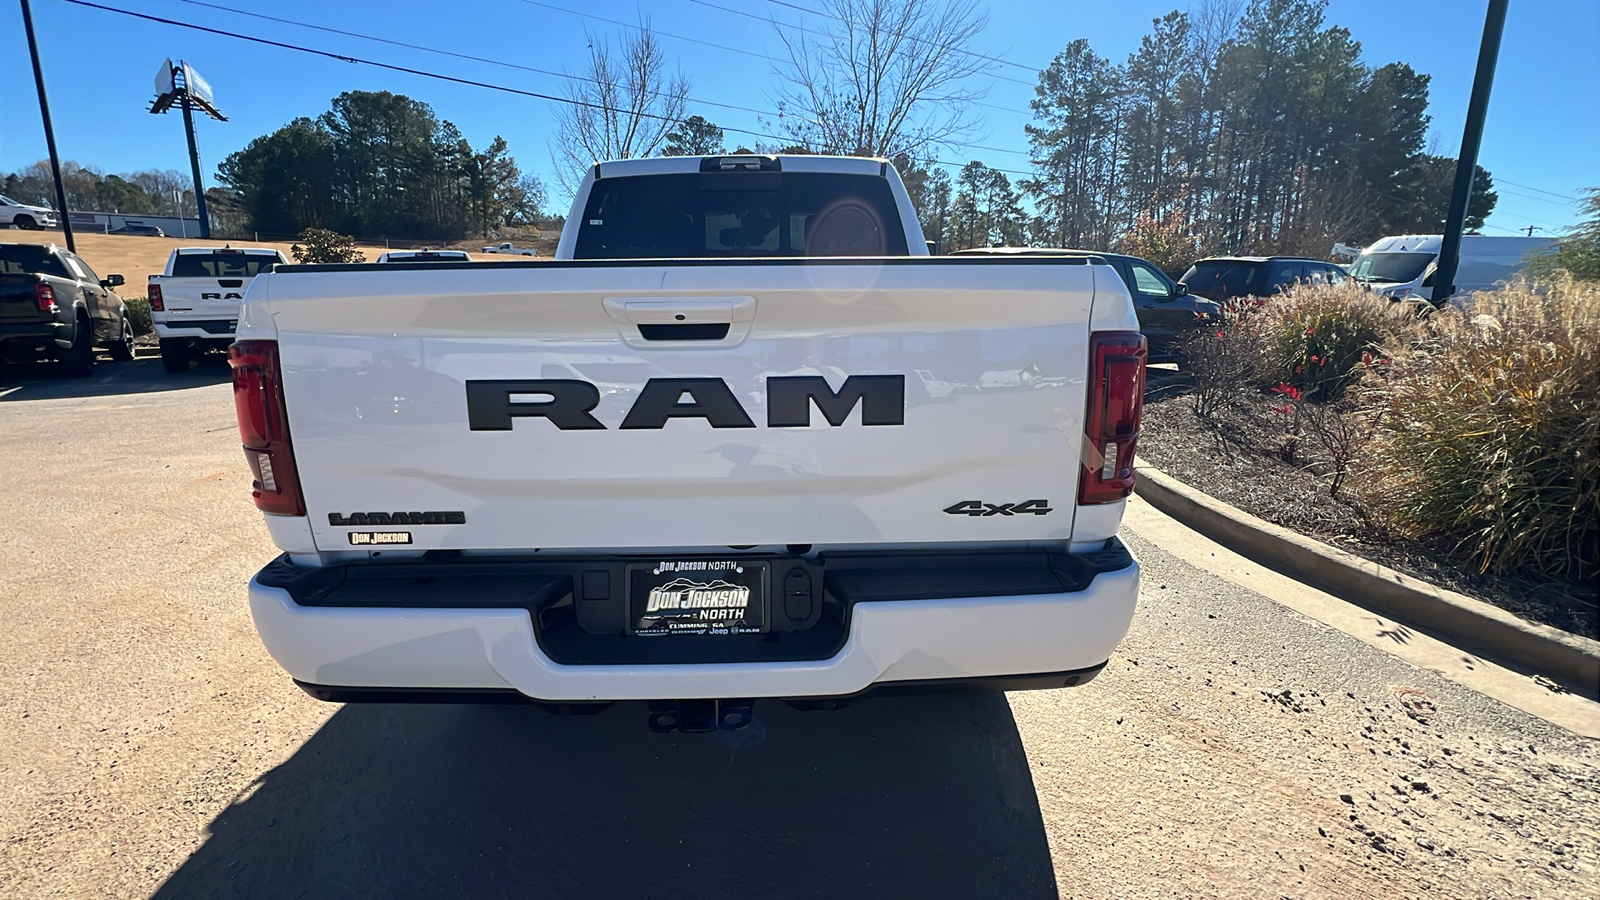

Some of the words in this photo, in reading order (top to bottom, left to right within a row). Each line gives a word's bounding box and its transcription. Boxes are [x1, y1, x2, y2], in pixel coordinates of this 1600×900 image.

[466, 374, 905, 430] RAM
[942, 500, 1053, 516] 4x4
[328, 511, 466, 526] LARAMIE
[352, 533, 369, 544] DON
[371, 533, 408, 544] JACKSON
[660, 562, 674, 572] DON
[675, 562, 707, 572] JACKSON
[708, 562, 737, 570] NORTH
[646, 590, 681, 612] DON
[681, 590, 750, 609] JACKSON
[700, 609, 744, 620] NORTH
